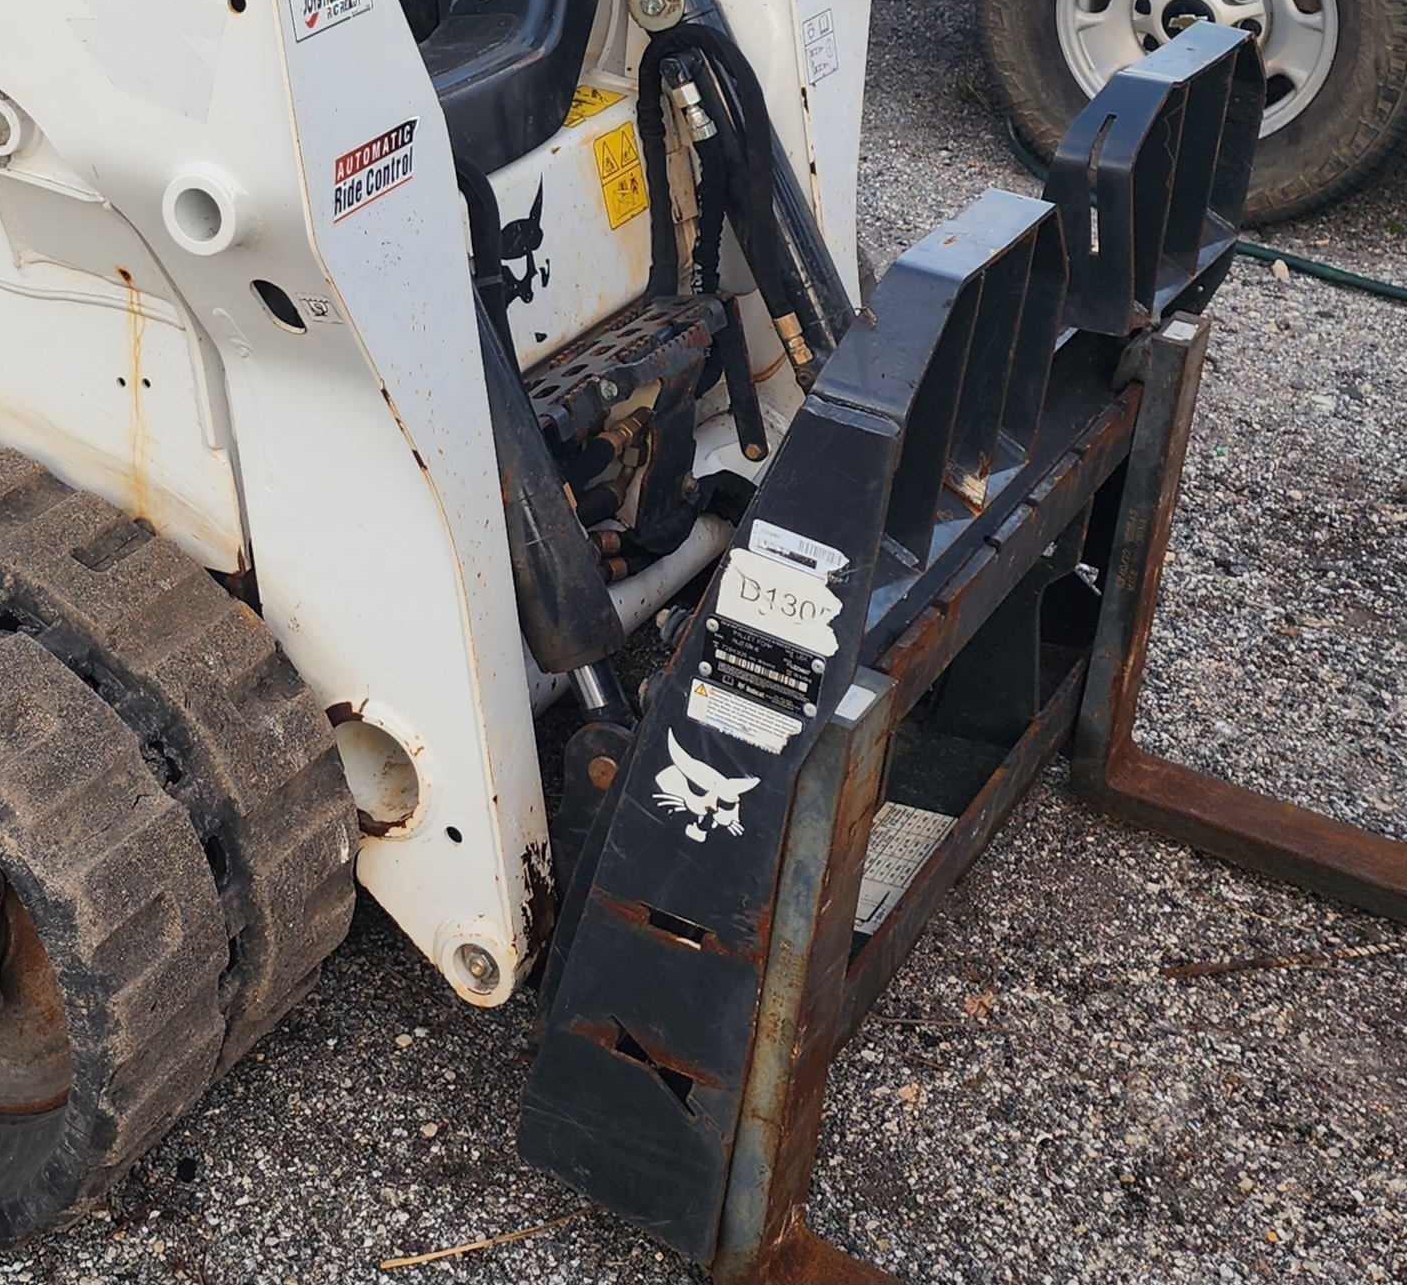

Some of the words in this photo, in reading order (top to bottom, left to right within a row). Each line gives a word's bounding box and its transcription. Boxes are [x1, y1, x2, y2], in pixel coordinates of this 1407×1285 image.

[334, 177, 363, 216] Ride
[365, 145, 414, 197] Control
[337, 123, 412, 181] AUTOMATIC
